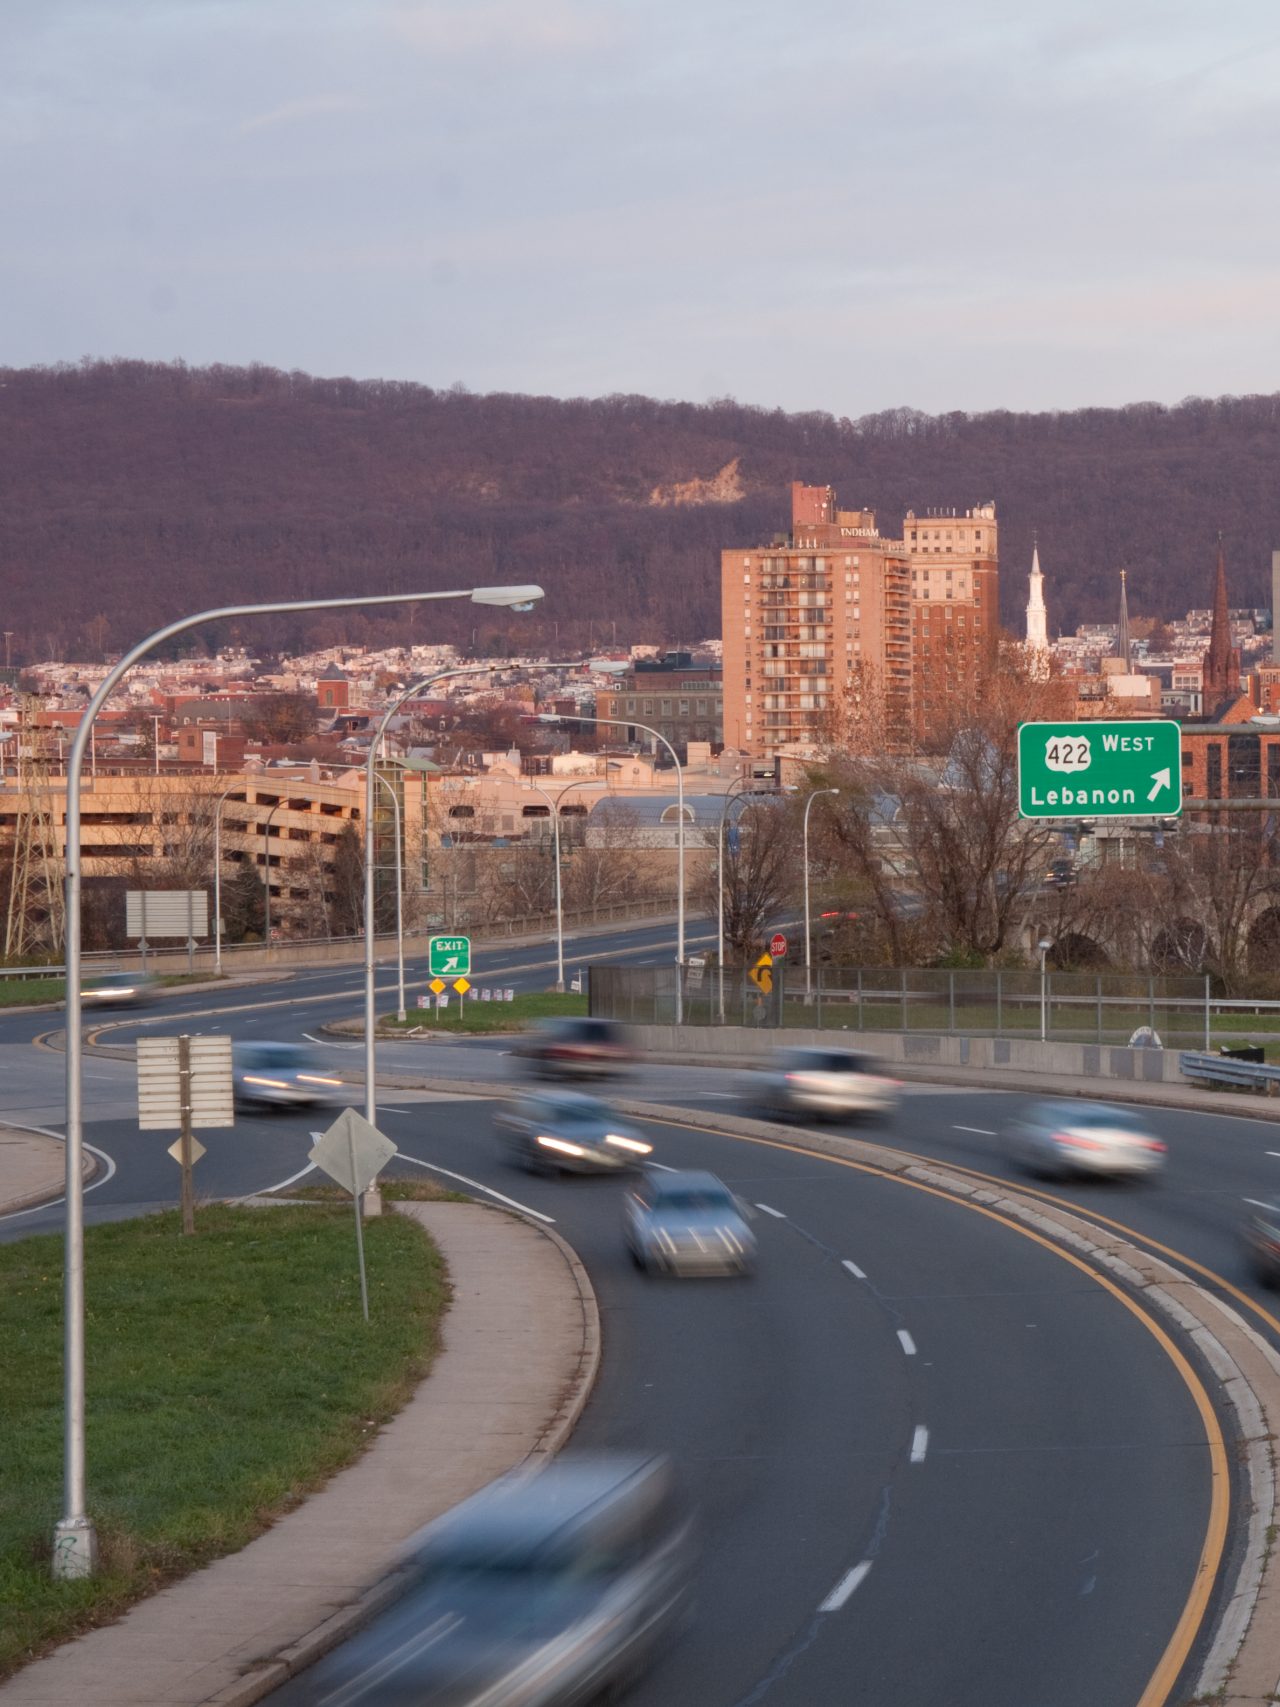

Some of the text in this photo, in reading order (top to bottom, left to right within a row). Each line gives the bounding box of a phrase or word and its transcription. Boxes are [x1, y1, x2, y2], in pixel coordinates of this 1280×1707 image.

[1048, 734, 1154, 764] 422 WEST
[1031, 787, 1135, 805] Lebanon
[436, 941, 463, 951] EXIT
[771, 941, 785, 952] STOP
